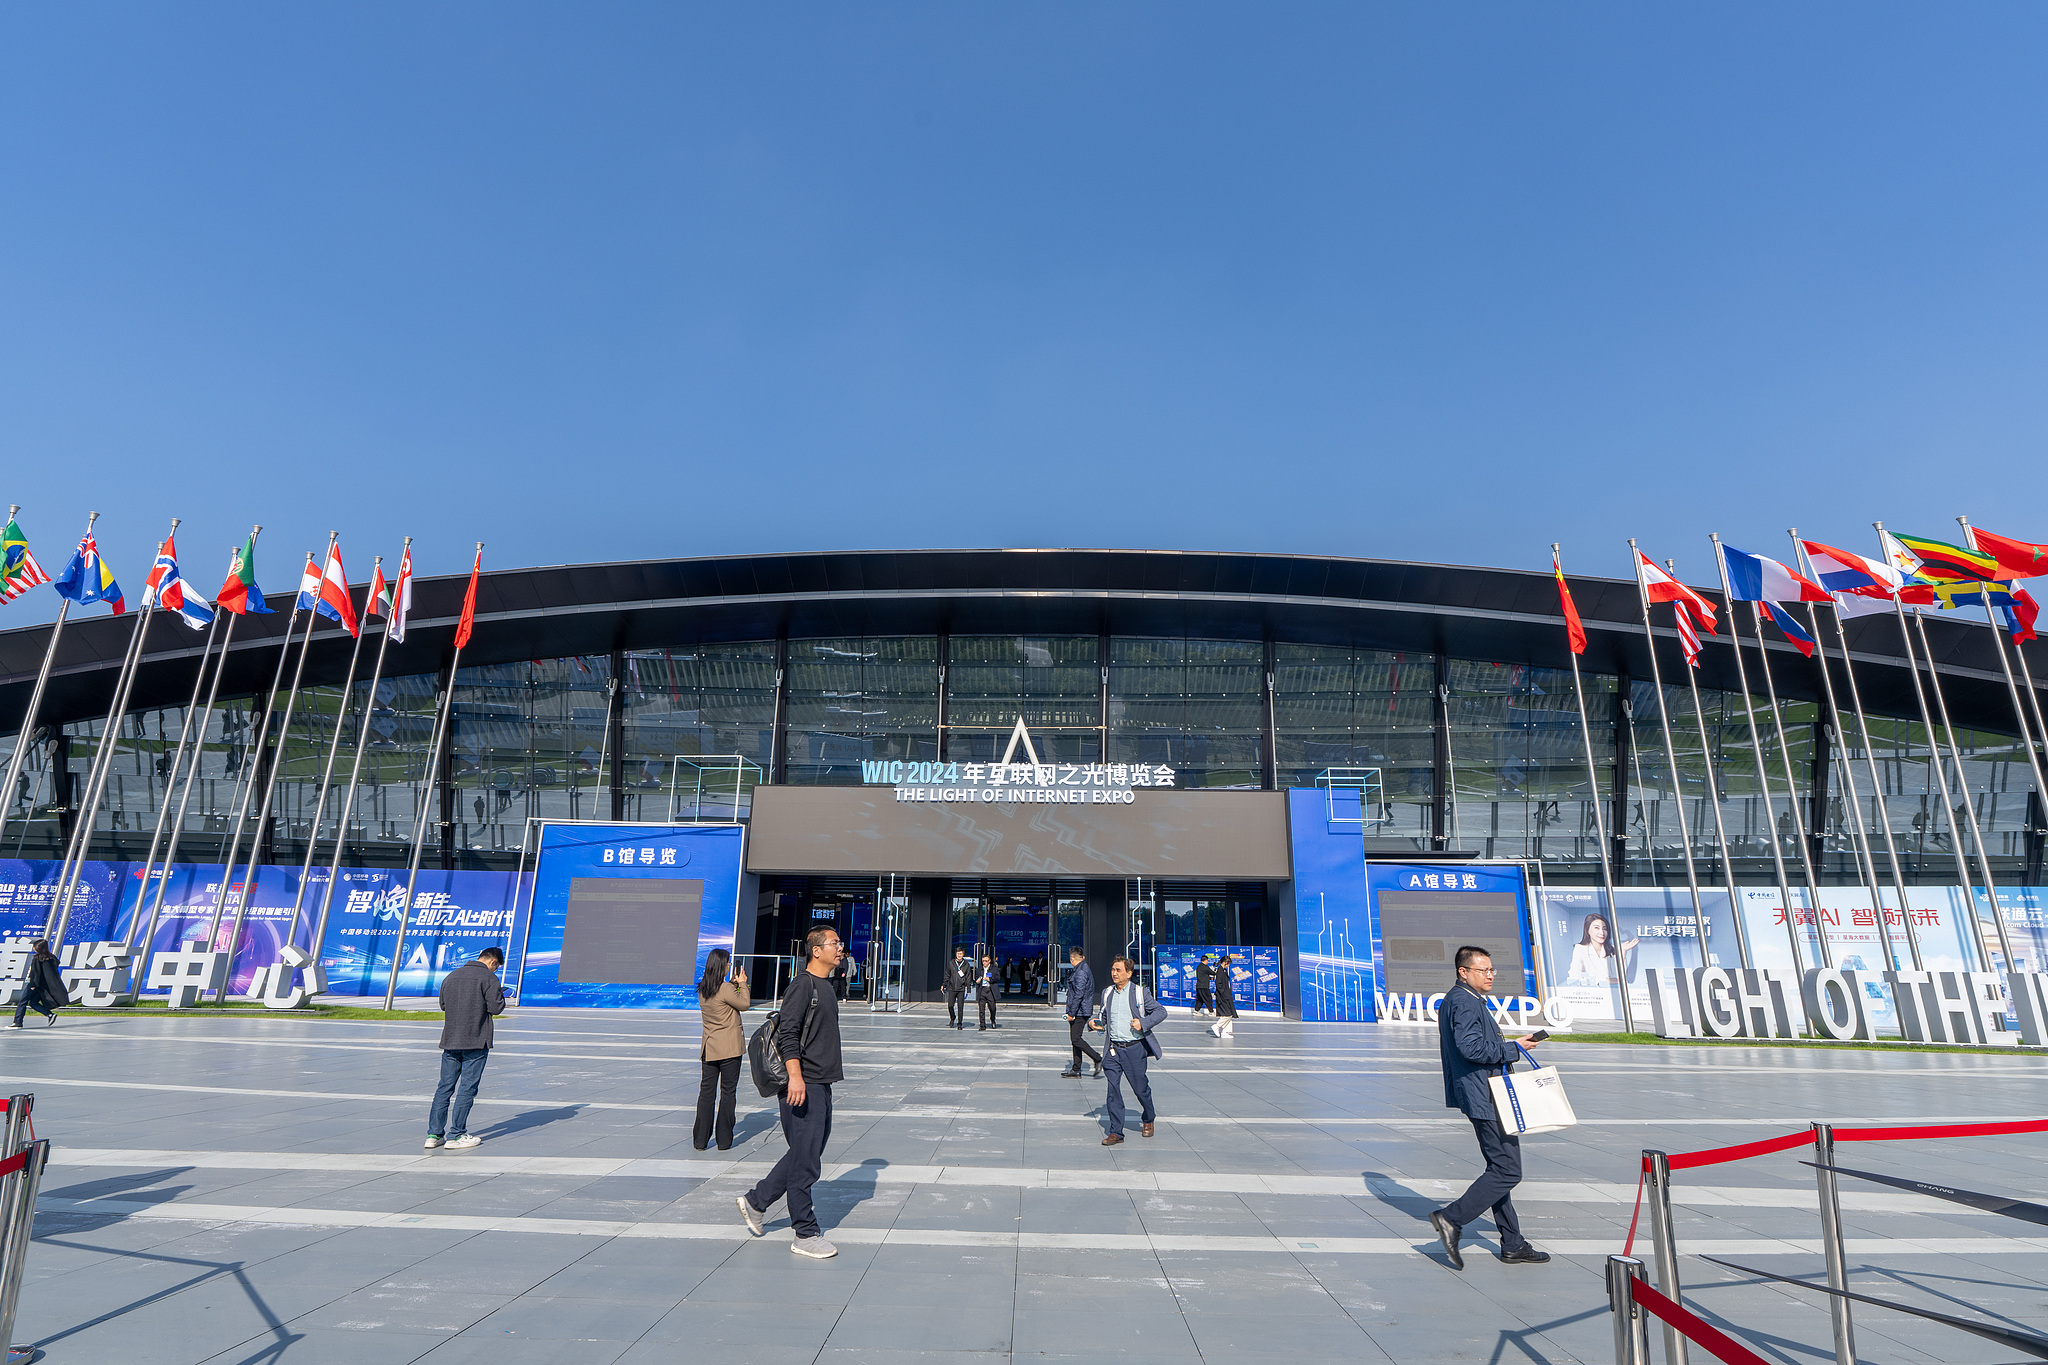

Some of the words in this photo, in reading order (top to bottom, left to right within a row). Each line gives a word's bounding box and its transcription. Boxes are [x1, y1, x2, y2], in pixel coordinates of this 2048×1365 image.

[862, 761, 902, 784] WIC
[907, 761, 958, 784] 2024
[963, 763, 1175, 786] 年互联网之光博览会
[894, 788, 925, 801] THE
[929, 788, 977, 802] LIGHT
[982, 788, 1003, 802] OF
[1008, 789, 1087, 803] INTERNET
[1092, 790, 1135, 804] EXPO
[603, 848, 676, 865] B馆导览
[18, 884, 90, 894] 世界互联会
[1410, 873, 1477, 889] A馆导览
[160, 905, 215, 914] 业大模型专家
[1773, 908, 1840, 926] 天翼AI
[1637, 925, 1710, 937] 让家更有I
[1375, 992, 1574, 1028] WICXPO
[1647, 967, 1800, 1038] LIGHT
[1804, 968, 1885, 1041] OF
[1884, 971, 2018, 1045] THE
[2008, 972, 2048, 1047] I
